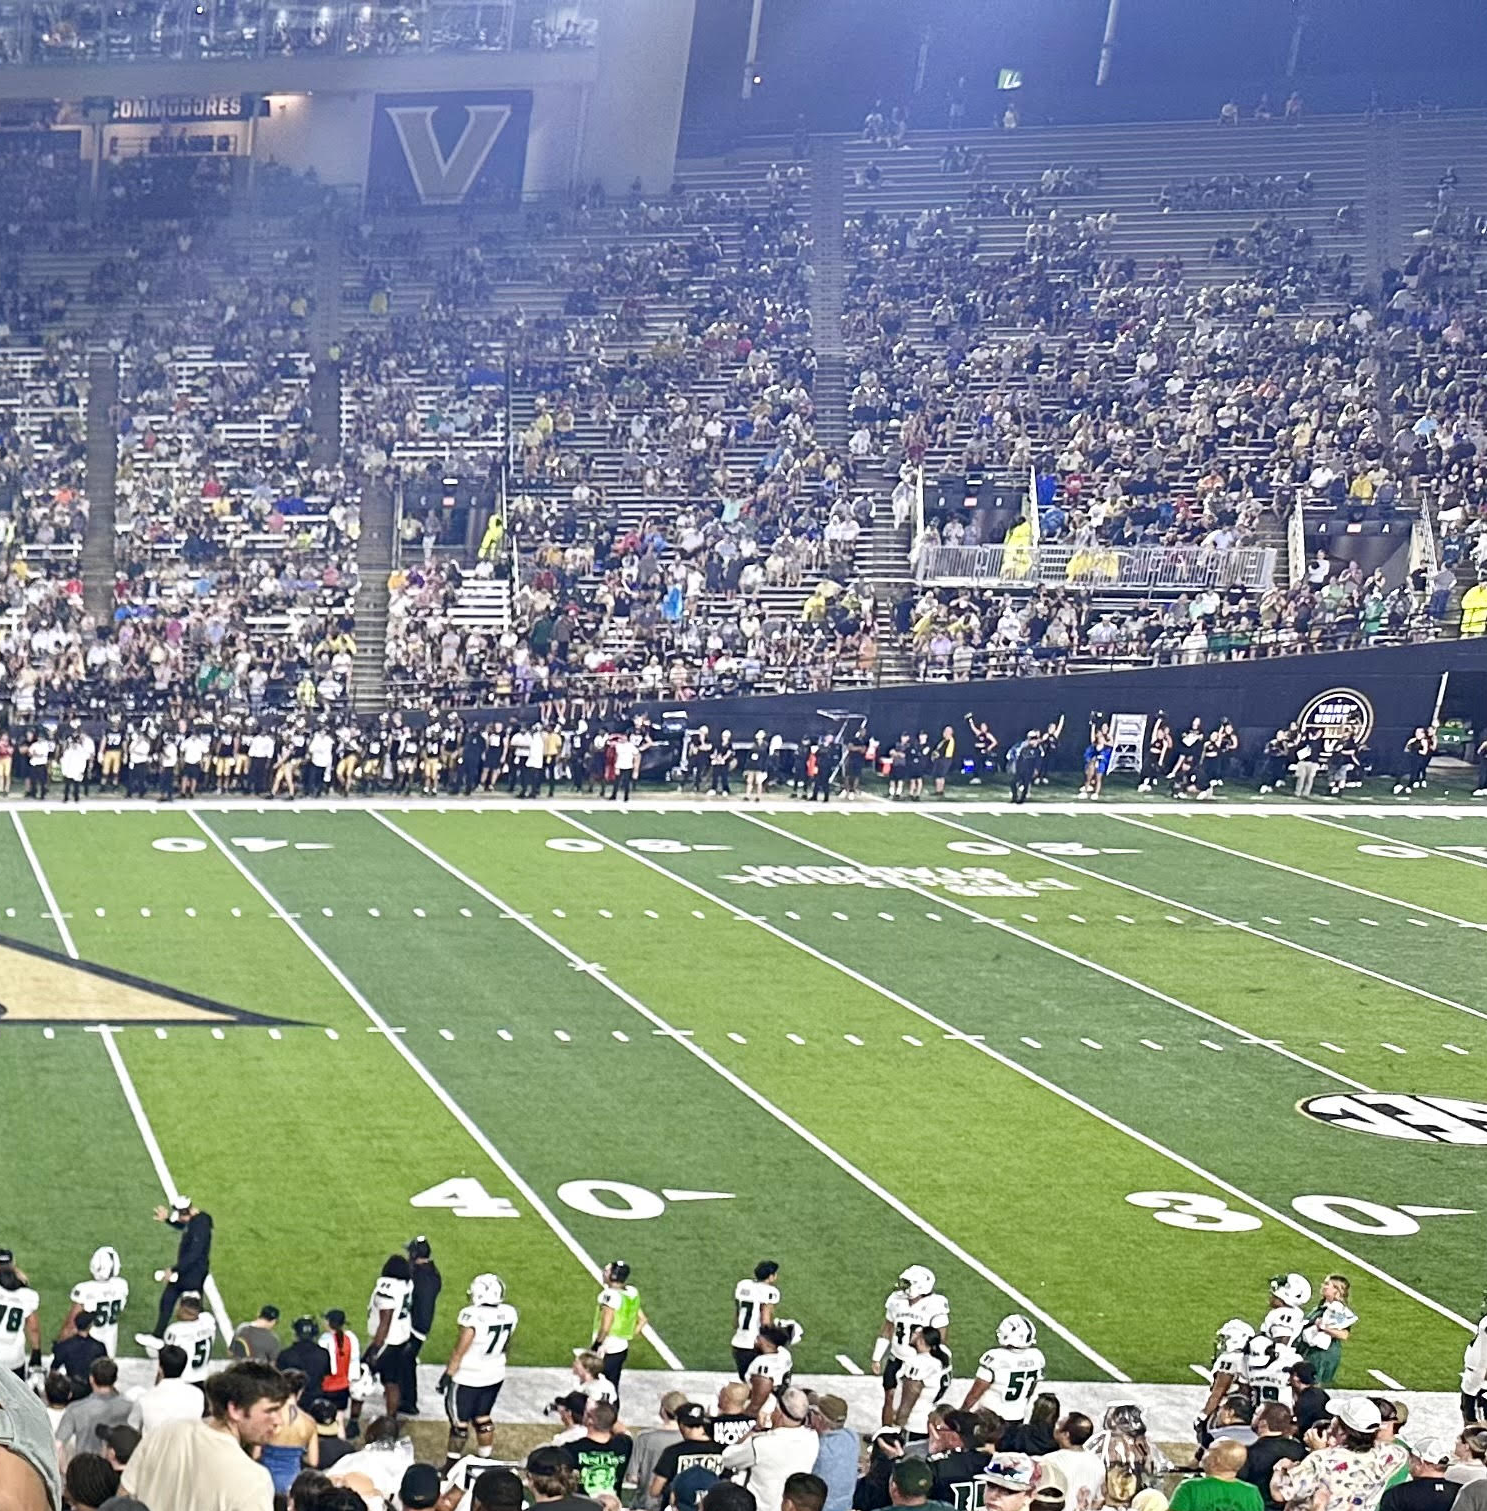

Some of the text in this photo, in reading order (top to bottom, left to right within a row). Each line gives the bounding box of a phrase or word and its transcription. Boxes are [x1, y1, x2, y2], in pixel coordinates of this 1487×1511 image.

[113, 97, 241, 118] COMMODORES
[385, 105, 512, 204] V
[410, 1177, 665, 1219] 40
[1124, 1191, 1420, 1236] 30
[485, 1323, 514, 1355] 77
[1004, 1369, 1039, 1402] 57
